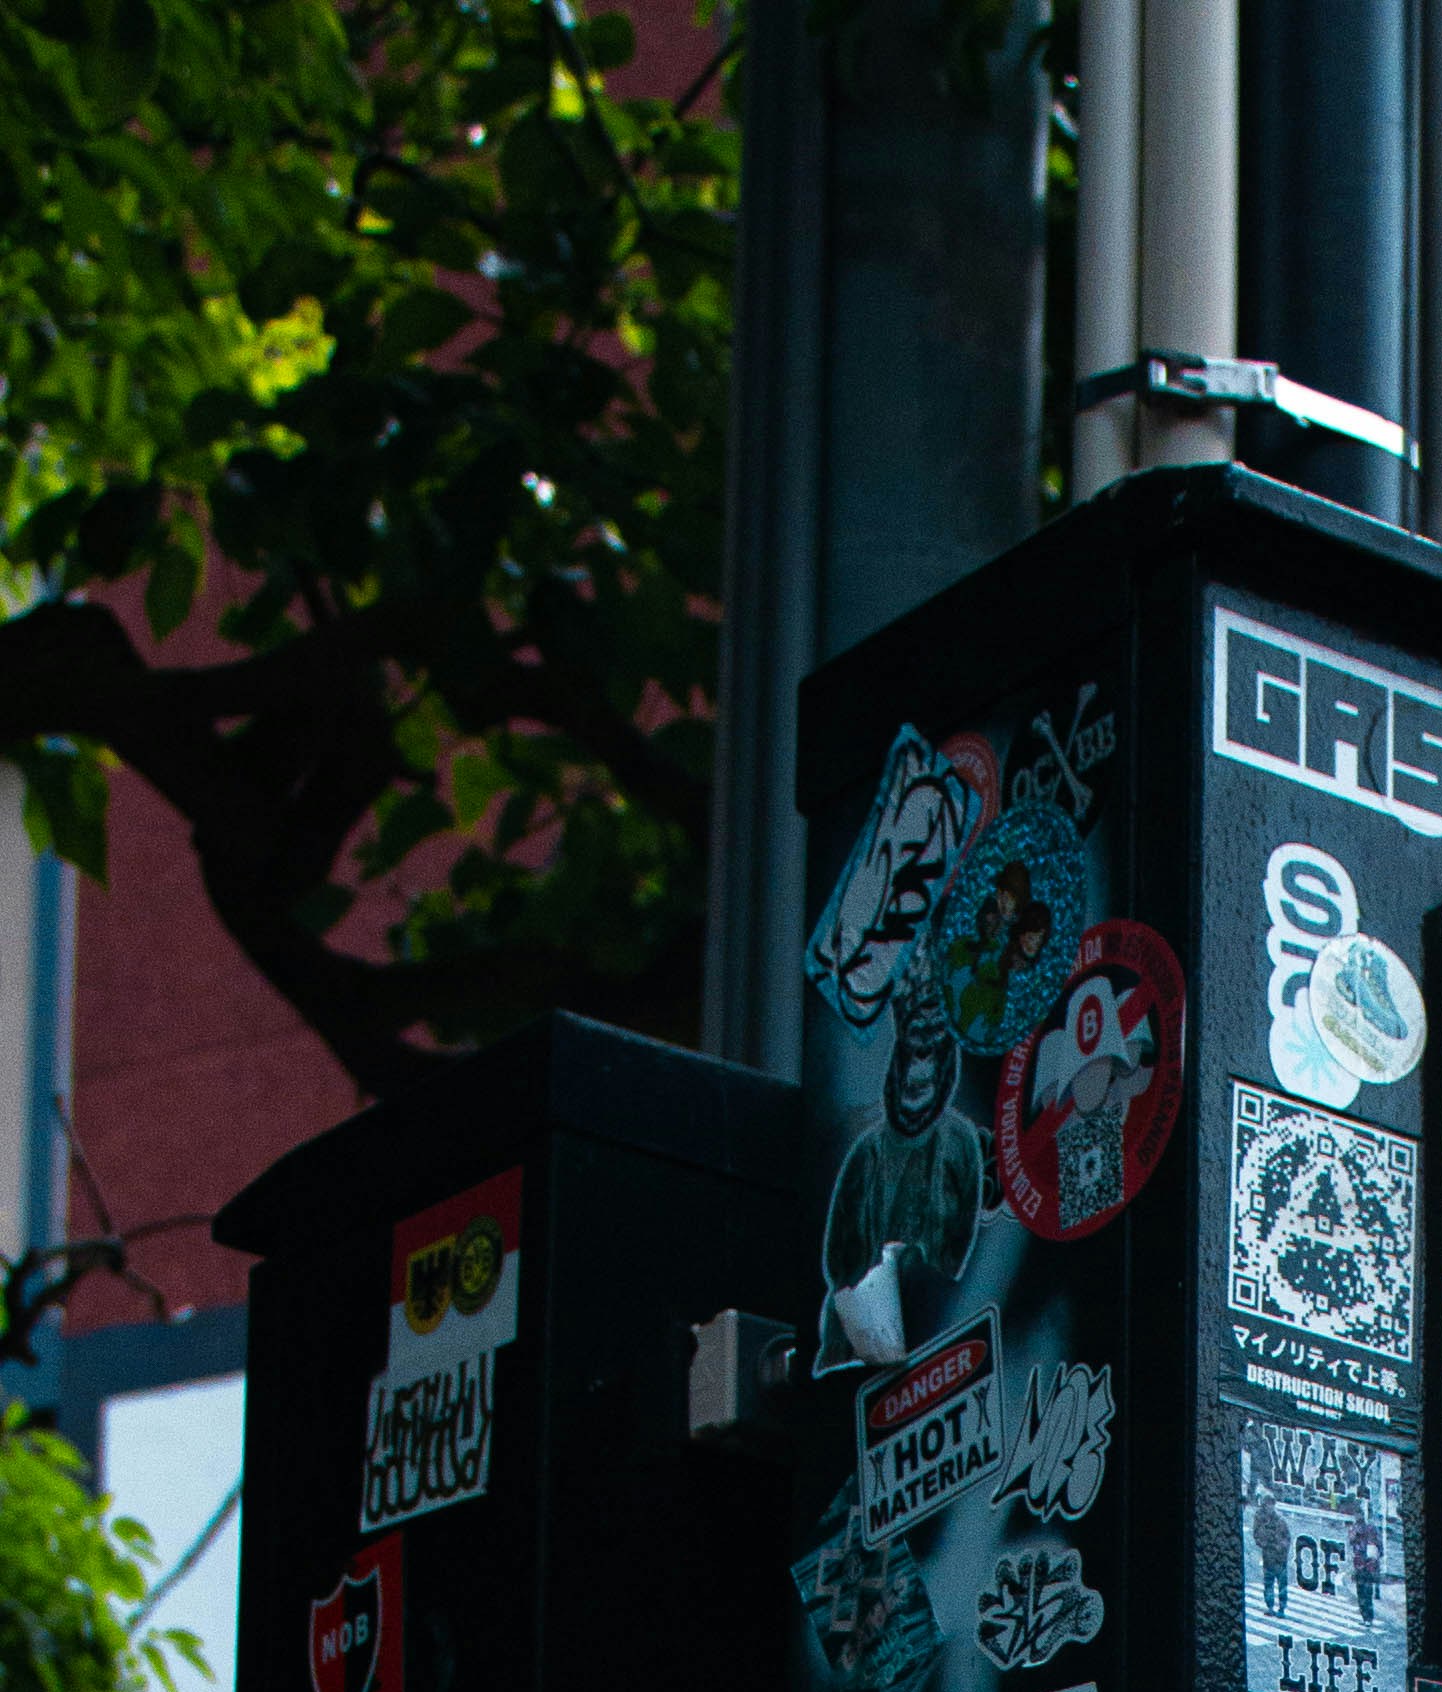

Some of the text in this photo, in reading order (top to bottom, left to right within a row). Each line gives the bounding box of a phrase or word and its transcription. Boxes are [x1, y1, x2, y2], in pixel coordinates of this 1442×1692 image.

[883, 1346, 973, 1422] DANGER
[892, 1402, 968, 1481] HOT
[1262, 1424, 1377, 1500] WAY
[868, 1433, 1001, 1535] MATERIAL
[1294, 1534, 1346, 1598] OF
